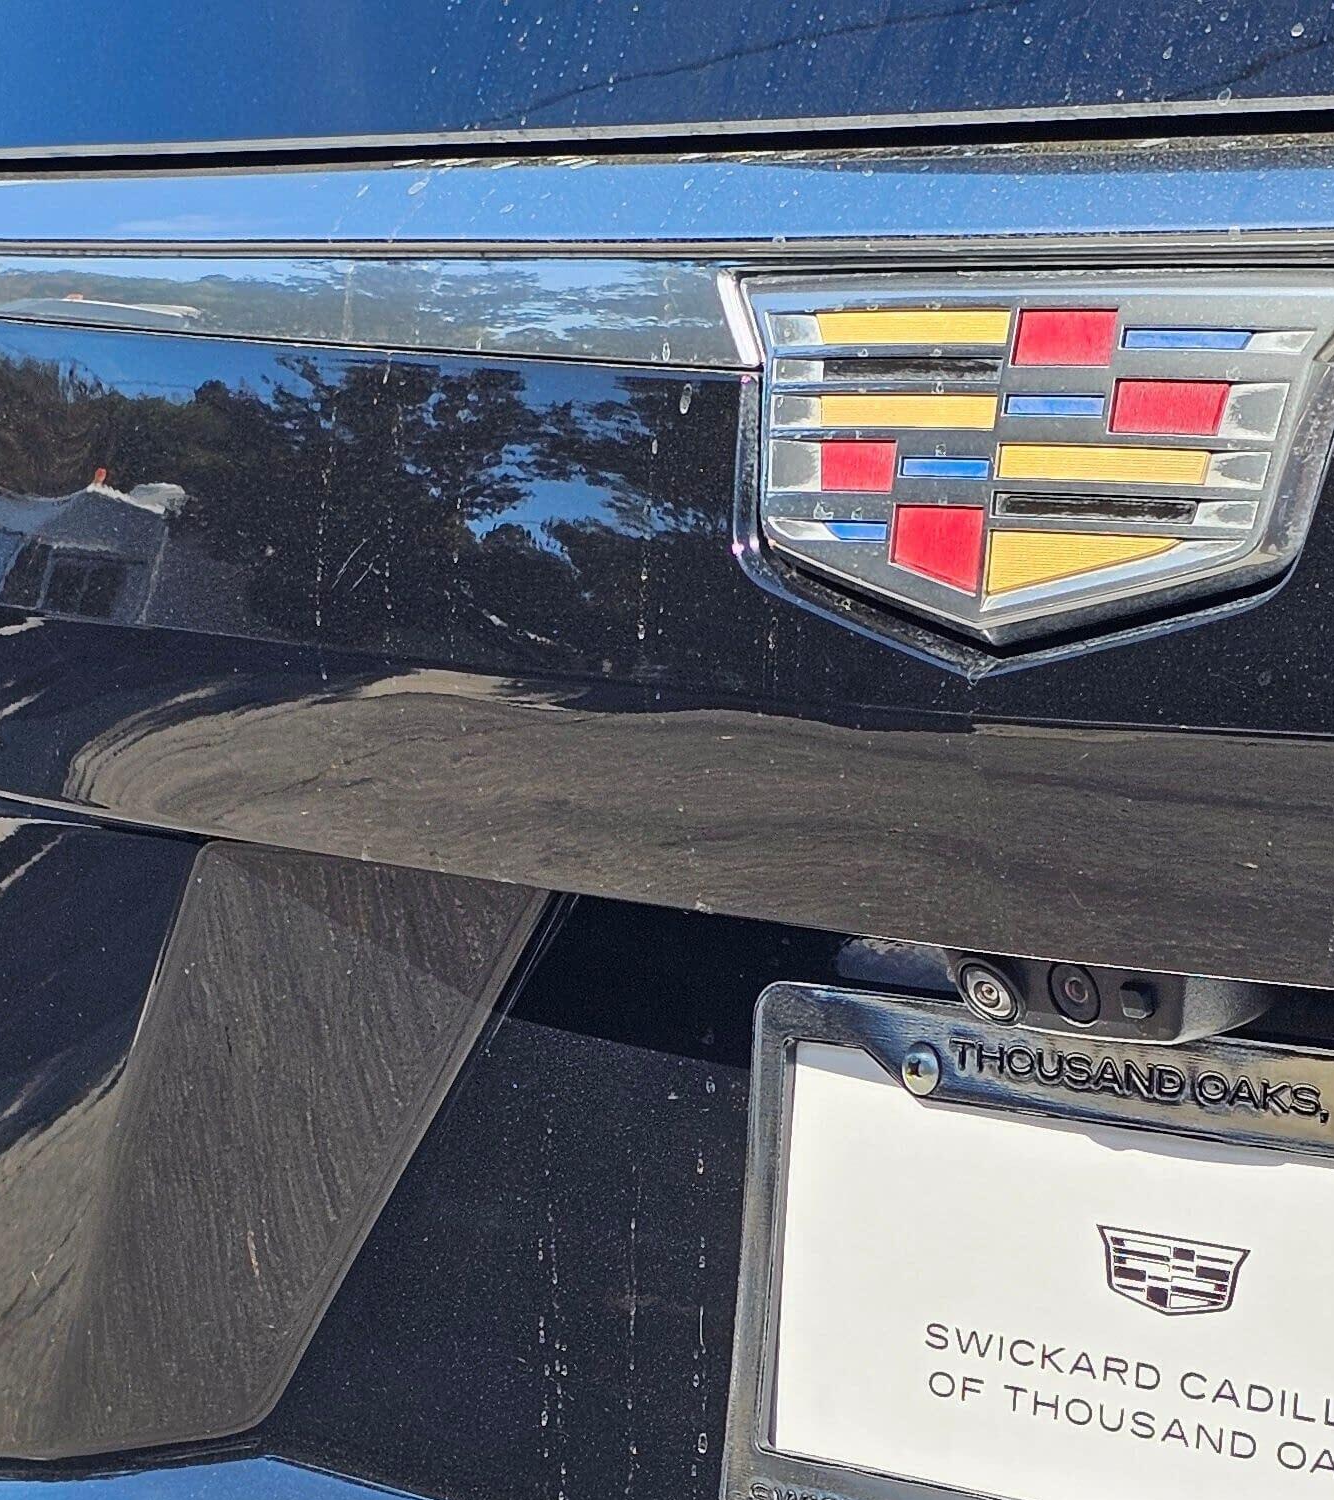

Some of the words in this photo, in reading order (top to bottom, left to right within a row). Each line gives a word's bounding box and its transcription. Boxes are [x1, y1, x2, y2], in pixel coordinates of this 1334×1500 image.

[949, 1037, 1186, 1103] THOUSAND
[1195, 1071, 1331, 1125] OAKS,
[924, 1322, 1162, 1391] SWICKARD
[928, 1370, 985, 1402] OF
[1003, 1383, 1257, 1460] THOUSAND
